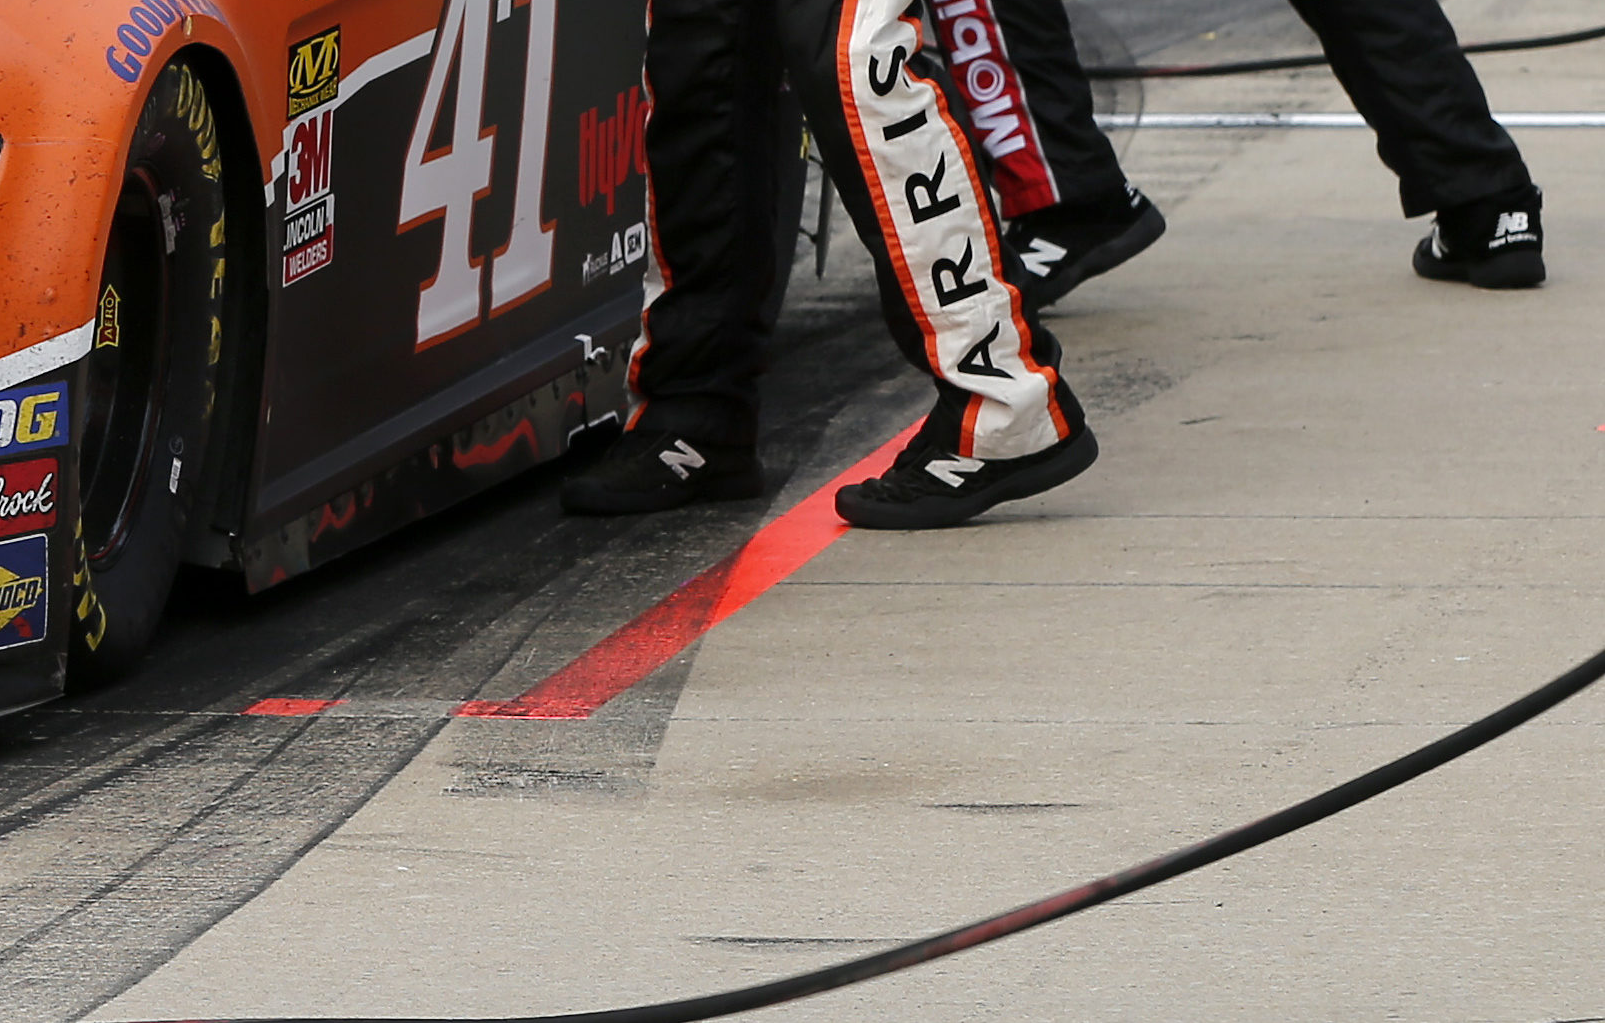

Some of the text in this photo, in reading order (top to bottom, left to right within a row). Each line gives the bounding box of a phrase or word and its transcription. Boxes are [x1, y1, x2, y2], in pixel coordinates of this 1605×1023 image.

[289, 109, 332, 207] 3M
[868, 44, 1014, 380] ARRIS
[288, 239, 328, 278] WELDERS
[104, 296, 115, 340] AERO
